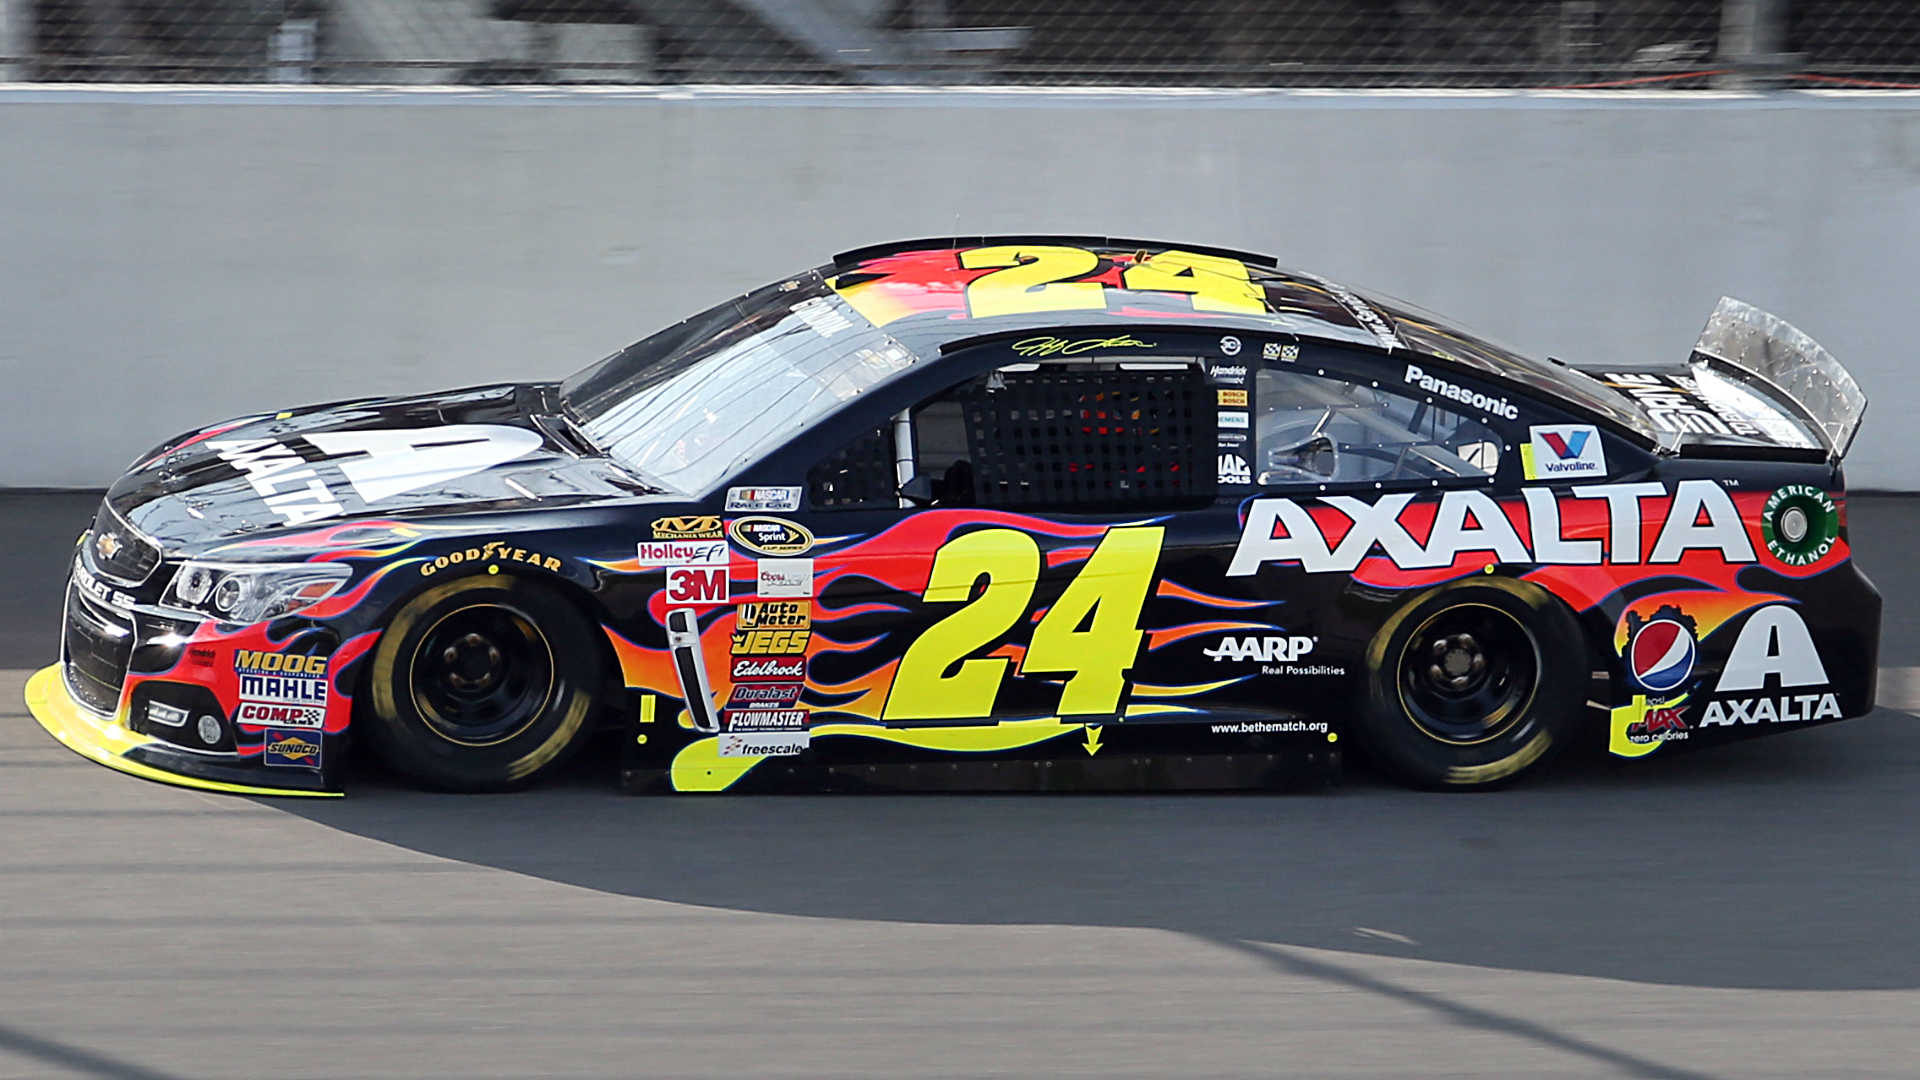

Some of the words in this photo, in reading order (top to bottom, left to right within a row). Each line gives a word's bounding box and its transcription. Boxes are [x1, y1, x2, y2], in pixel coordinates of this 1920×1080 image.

[959, 246, 1266, 318] 24
[1210, 366, 1247, 377] Hendrick
[1405, 365, 1518, 419] Panasonic
[1545, 461, 1596, 472] Valvoline
[205, 437, 348, 527] AXALTA
[1763, 485, 1836, 521] AMERICAN
[758, 532, 786, 543] Sprint
[1226, 479, 1757, 577] AXALTA
[420, 546, 562, 576] GOODYEAR
[641, 544, 693, 563] Holley
[692, 544, 725, 561] EFI
[1768, 537, 1836, 565] ETHANOL
[669, 570, 726, 601] 3M
[111, 591, 136, 609] SS
[760, 603, 798, 613] Auto
[757, 614, 806, 625] Meter
[882, 526, 1166, 720] 24
[732, 631, 810, 654] JEGS
[1203, 636, 1313, 662] AARP
[1715, 605, 1830, 692] A
[235, 650, 327, 674] MOOG
[733, 660, 803, 677] Edelbrock
[1262, 666, 1283, 674] Real
[1287, 666, 1345, 675] Possibilities
[241, 676, 327, 701] MAHLE
[735, 686, 797, 700] Duralast
[242, 706, 304, 721] COMP
[1699, 693, 1842, 728] AXALTA
[728, 711, 804, 732] FLOWMASTER
[1211, 721, 1328, 733] www.bethematch.org
[1652, 730, 1688, 741] calories
[269, 743, 319, 754] SUNOCO
[742, 743, 803, 755] freescale
